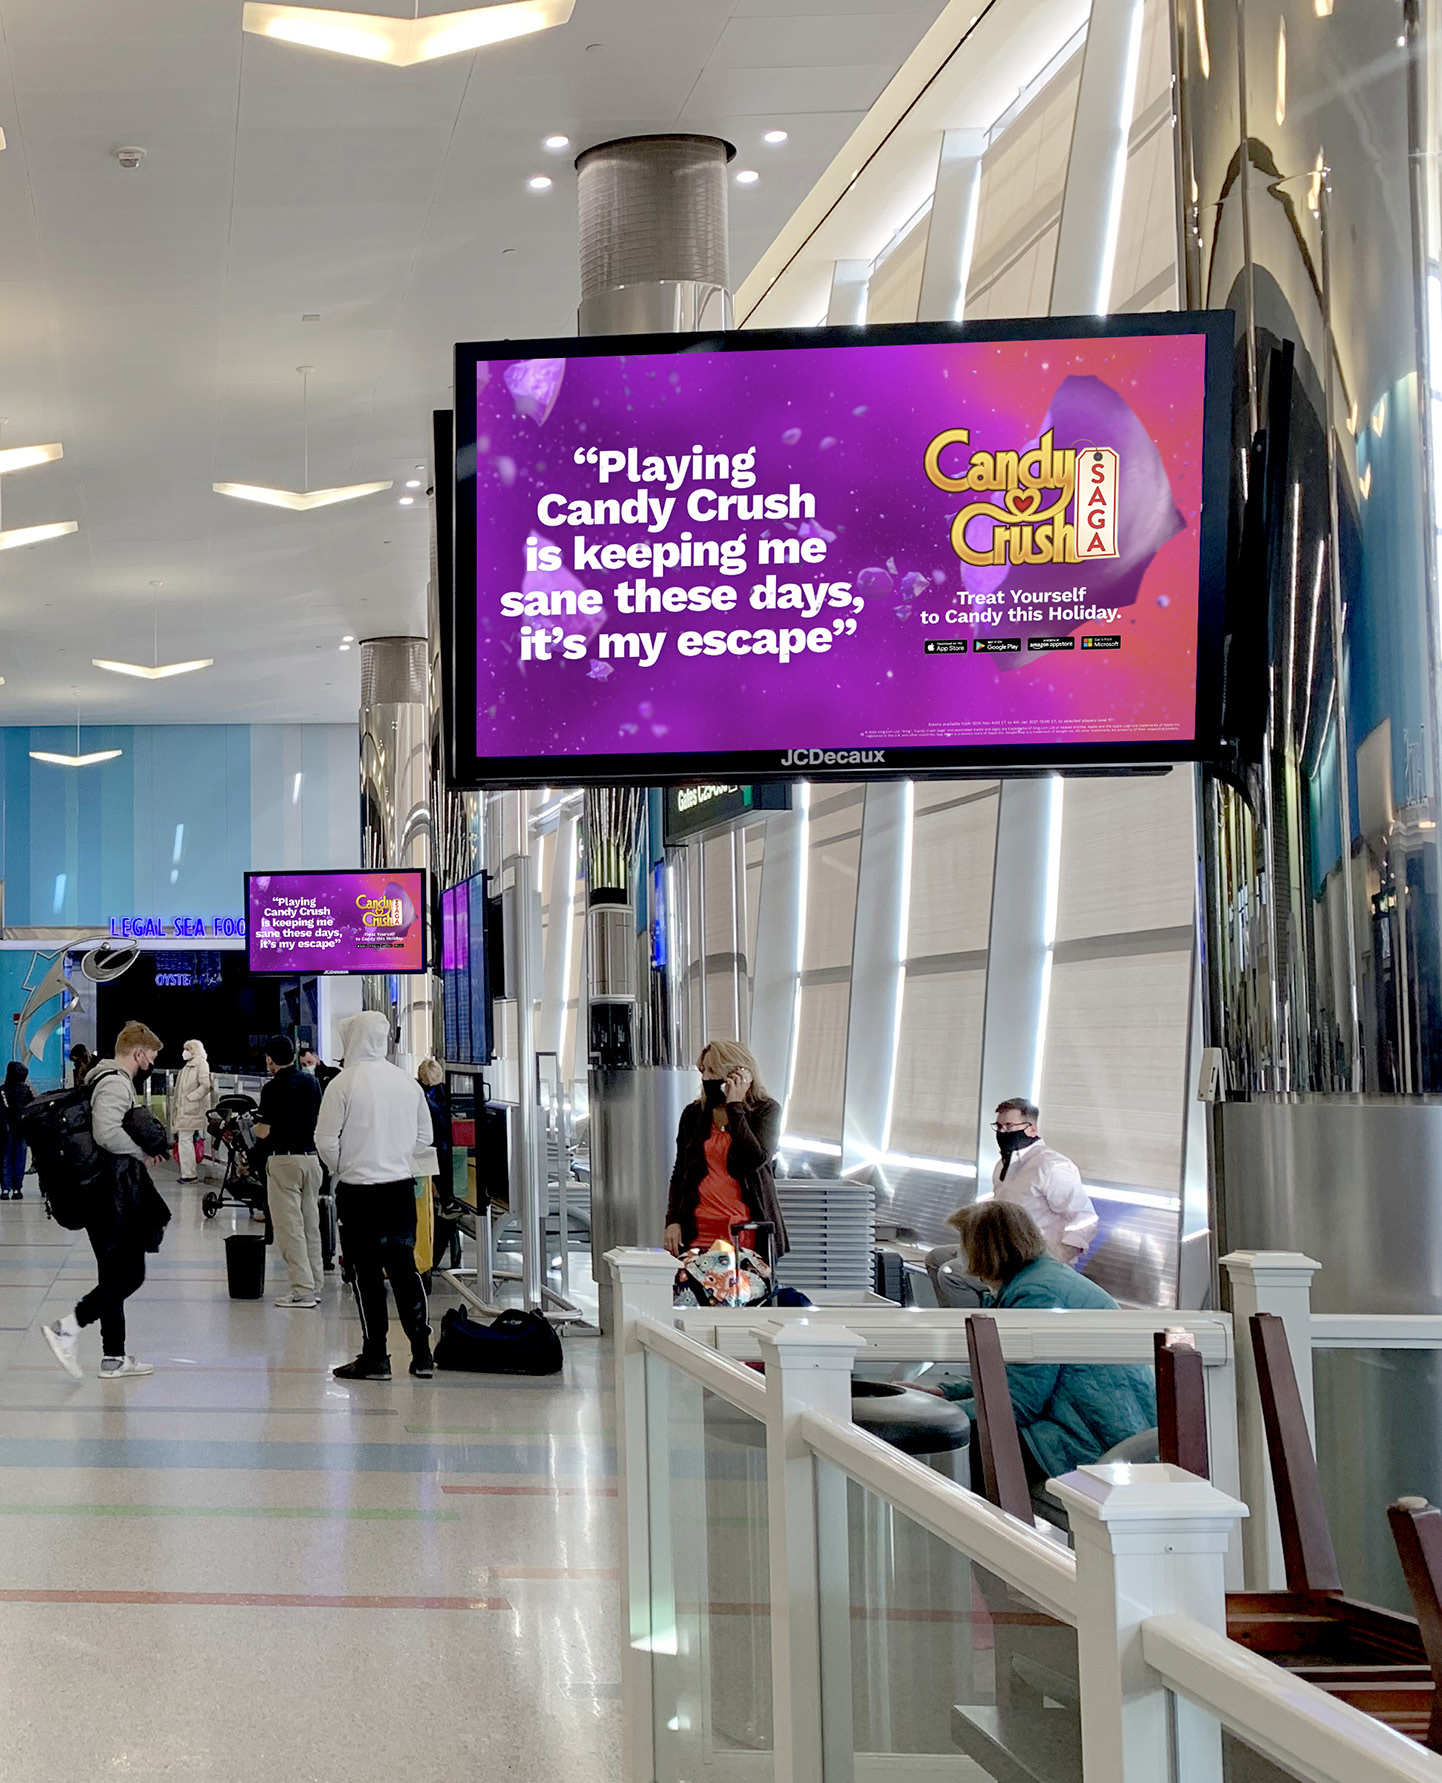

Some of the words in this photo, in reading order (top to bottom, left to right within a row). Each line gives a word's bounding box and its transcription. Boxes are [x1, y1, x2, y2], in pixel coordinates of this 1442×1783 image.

[573, 445, 756, 491] “Playing
[924, 426, 1077, 502] Candy
[537, 488, 676, 533] Candy
[687, 483, 815, 521] Crush
[1087, 463, 1107, 552] SAGA
[951, 503, 1085, 566] Crush
[526, 536, 562, 572] is
[574, 531, 747, 577] keeping
[758, 537, 827, 565] me
[500, 588, 603, 617] sane
[614, 578, 737, 614] these
[749, 574, 865, 618] days,
[956, 590, 1005, 605] Treat
[1010, 587, 1087, 604] Yourself
[920, 610, 939, 624] to
[945, 608, 1003, 626] Candy
[1008, 606, 1043, 622] this
[1048, 605, 1122, 623] Holiday.
[520, 625, 587, 661] it’s
[599, 631, 667, 668] my
[677, 617, 857, 663] escape”
[781, 748, 886, 766] JCDecaux
[264, 907, 297, 918] Candy
[299, 906, 331, 916] Crush
[272, 897, 317, 908] “Playing
[355, 894, 392, 912] Candy
[110, 916, 168, 938] LEGAL
[173, 917, 207, 938] SEA
[261, 917, 271, 927] is
[272, 917, 315, 929] keeping
[362, 911, 395, 927] Crush
[282, 928, 312, 938] these
[315, 928, 343, 939] days,
[279, 941, 296, 950] my
